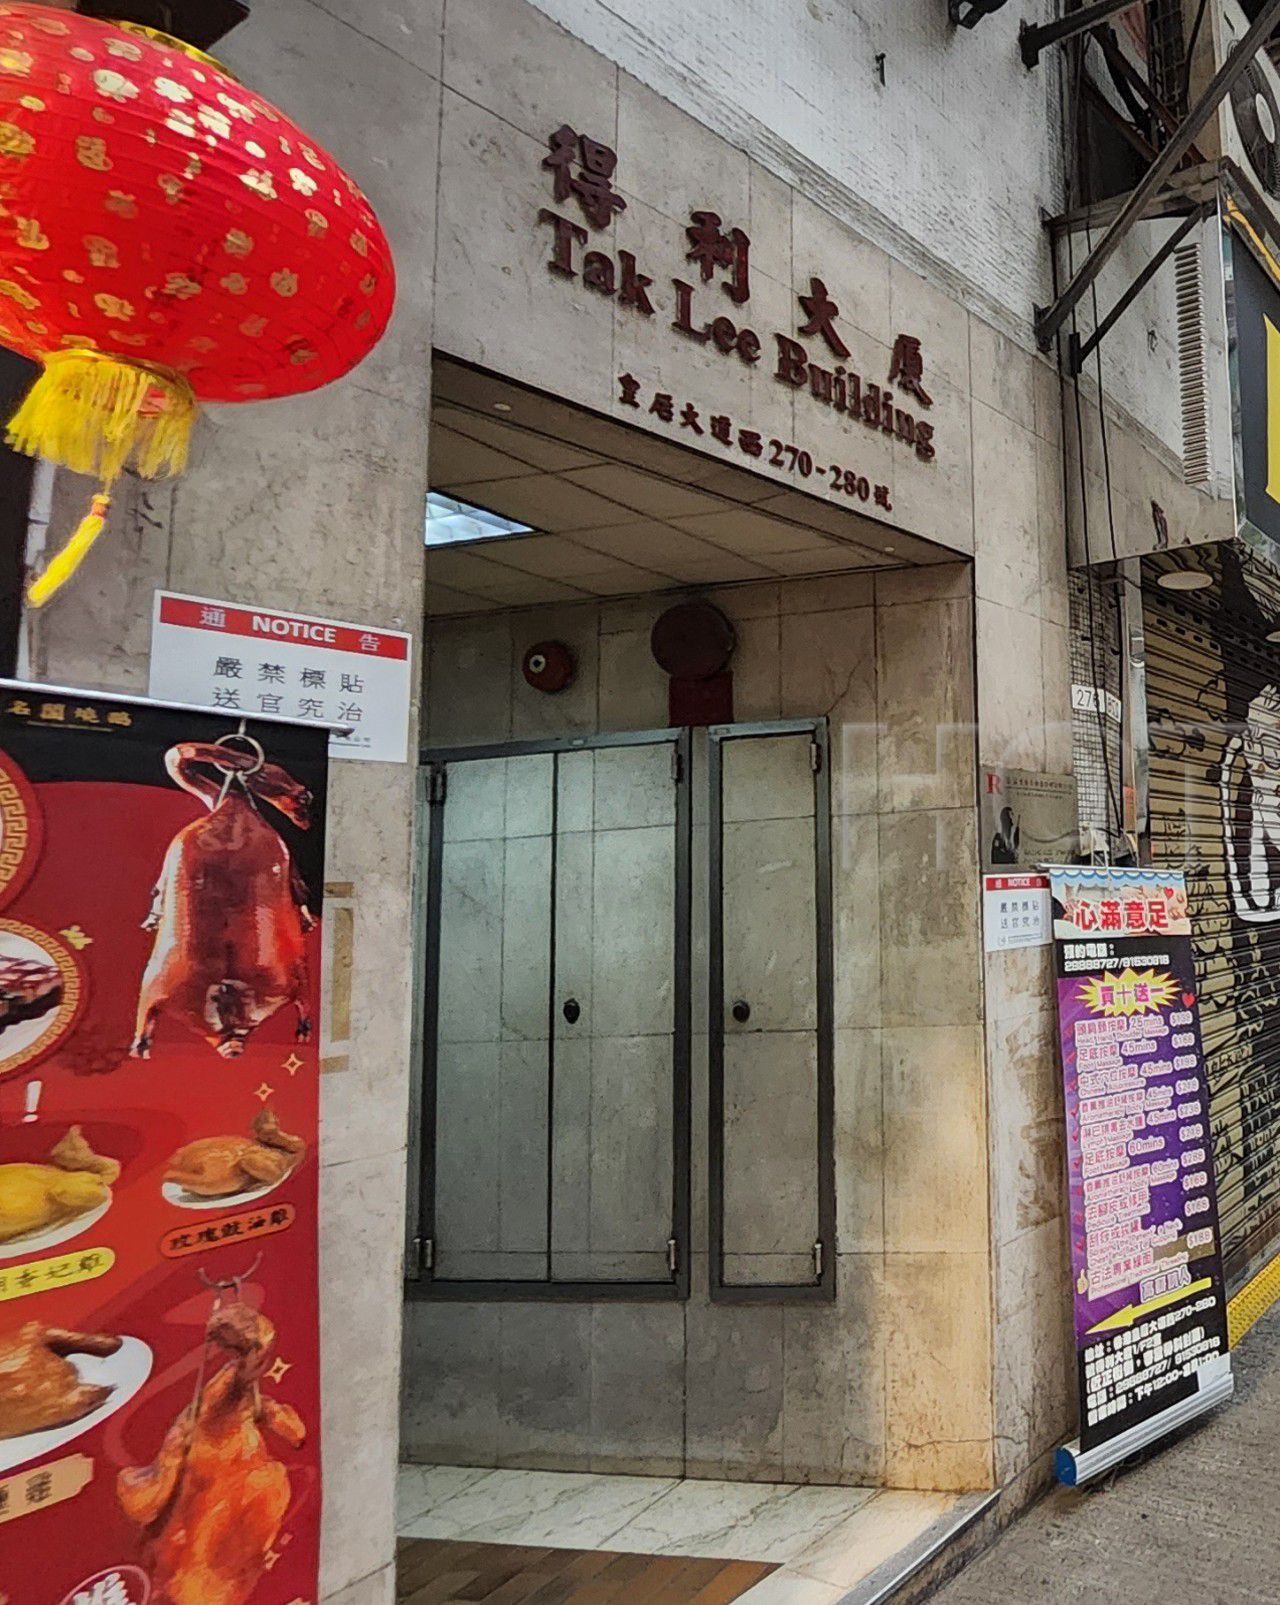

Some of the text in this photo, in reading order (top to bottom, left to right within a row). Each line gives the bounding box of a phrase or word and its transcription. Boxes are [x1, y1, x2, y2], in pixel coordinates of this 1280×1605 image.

[539, 208, 936, 460] Tak Lee Building
[199, 606, 382, 652] 通 NOTICE 告
[213, 656, 364, 694] 嚴禁標貼
[212, 686, 364, 723] 送官究治
[1074, 899, 1169, 932] 心滿意足
[1100, 982, 1165, 1006] 買十送一
[1144, 1026, 1169, 1037] Massage
[1122, 1041, 1157, 1055] 45mins
[1096, 1058, 1122, 1068] Massage
[1141, 1061, 1172, 1076] 45mins
[1147, 1087, 1174, 1099] 45mins
[1145, 1098, 1172, 1110] Massage
[1148, 1110, 1177, 1125] 45mins
[1107, 1131, 1133, 1144] Massage
[1128, 1137, 1165, 1155] 60mins
[1103, 1157, 1130, 1170] Massage
[1151, 1159, 1179, 1174] 60mins
